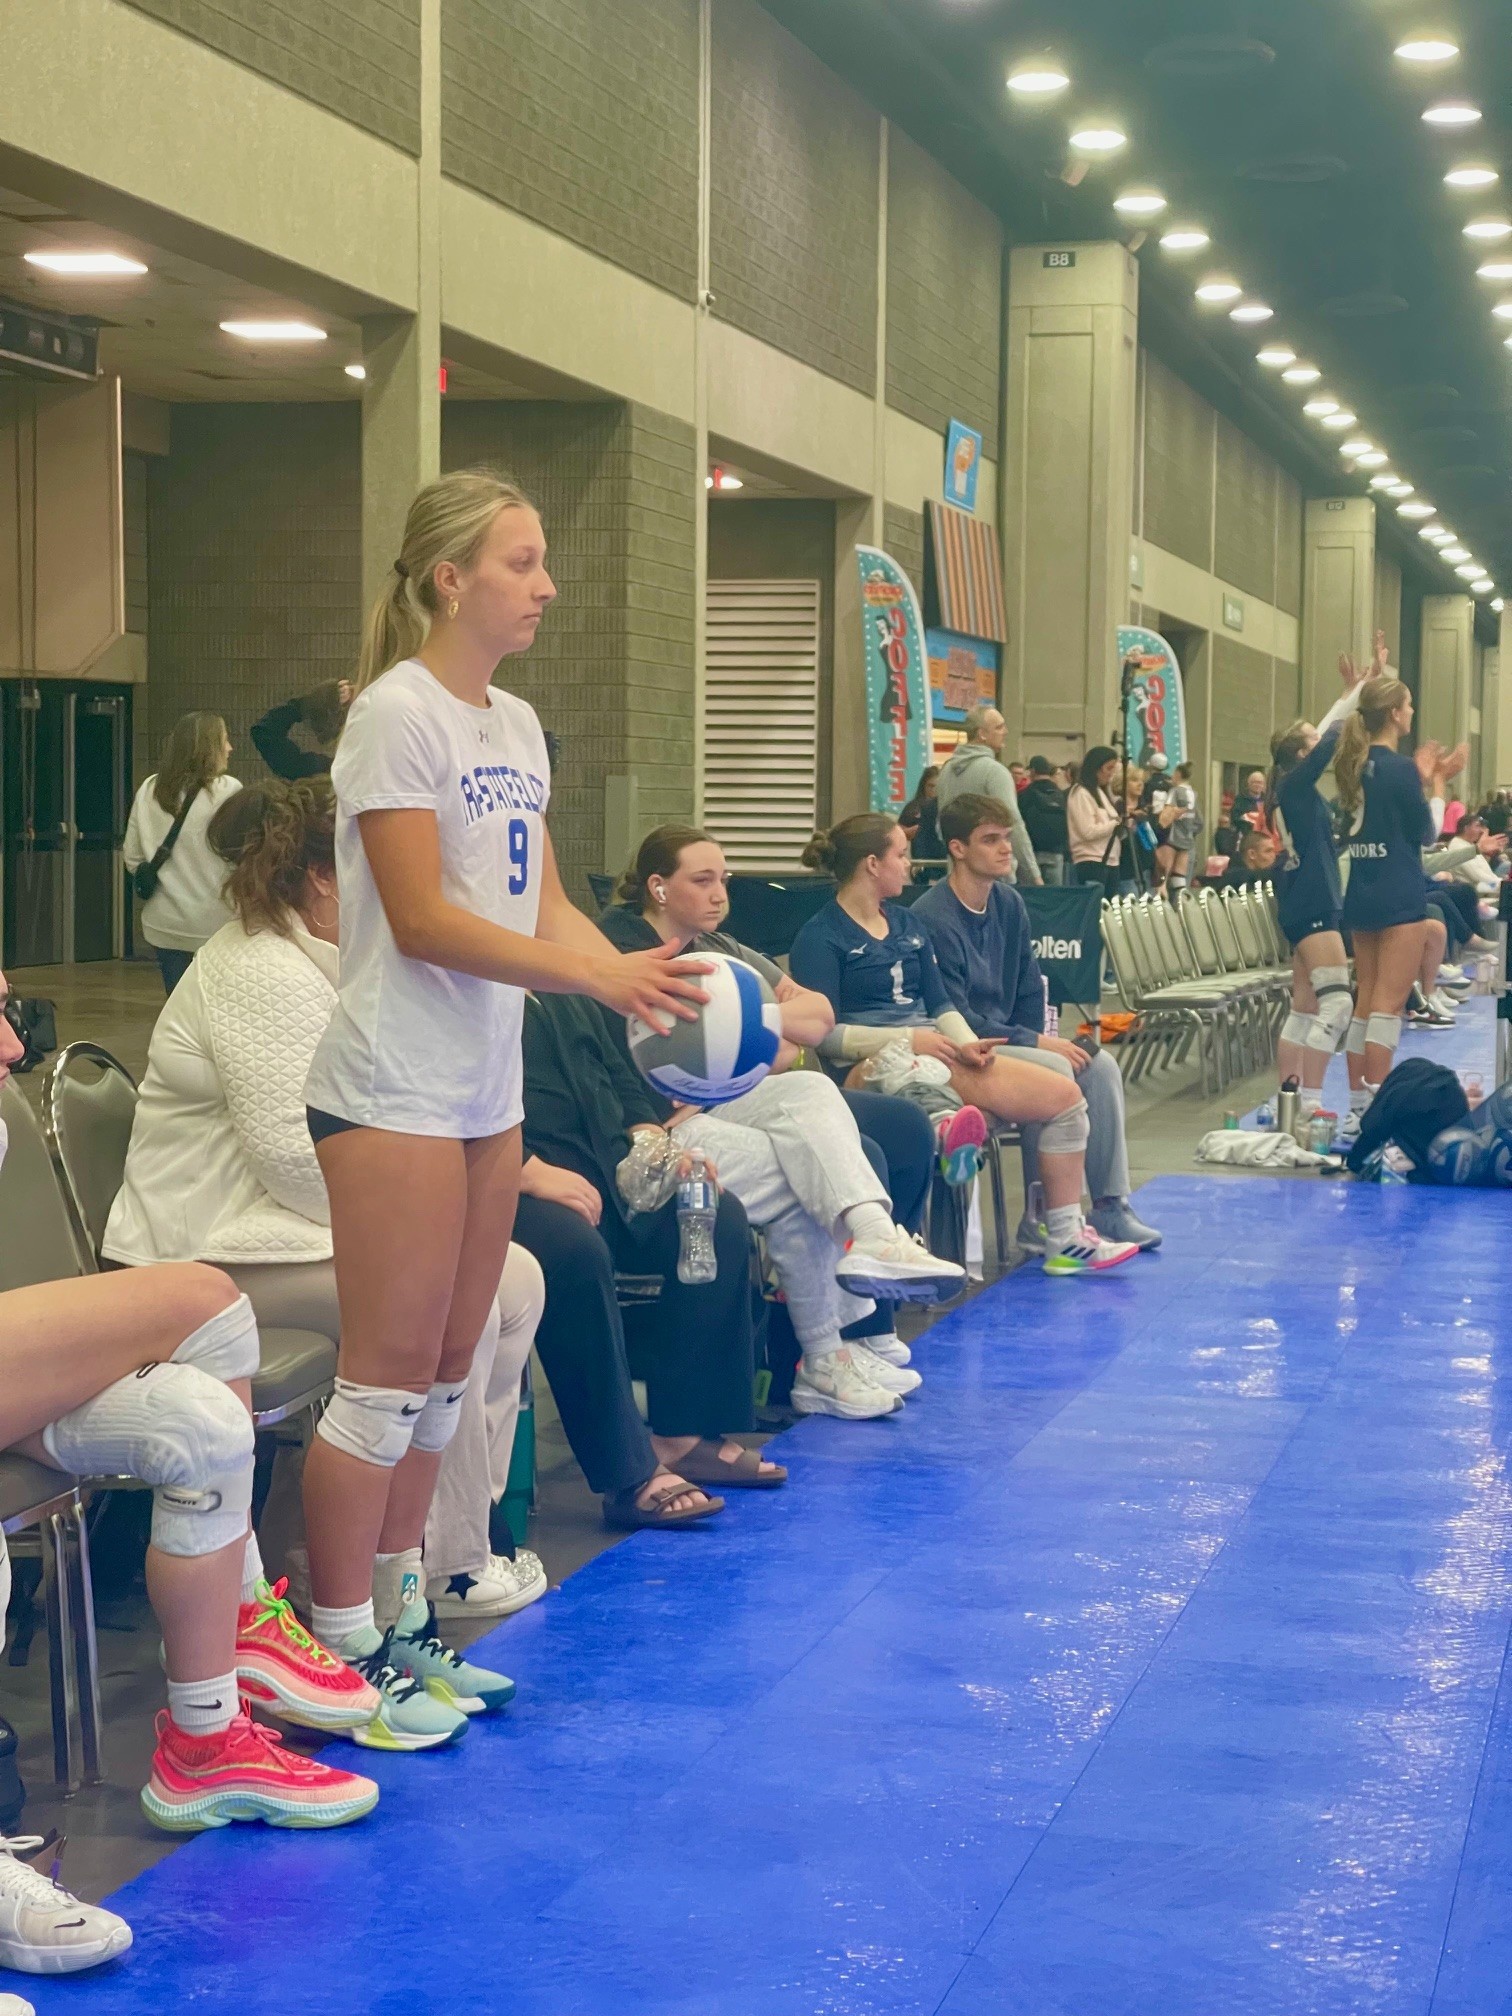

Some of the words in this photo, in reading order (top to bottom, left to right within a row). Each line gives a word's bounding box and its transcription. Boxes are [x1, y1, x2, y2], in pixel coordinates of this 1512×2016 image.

[1049, 253, 1070, 266] B8
[508, 818, 529, 896] 9
[1348, 842, 1388, 858] NIORS
[1029, 935, 1083, 960] olten
[889, 959, 914, 1005] 1
